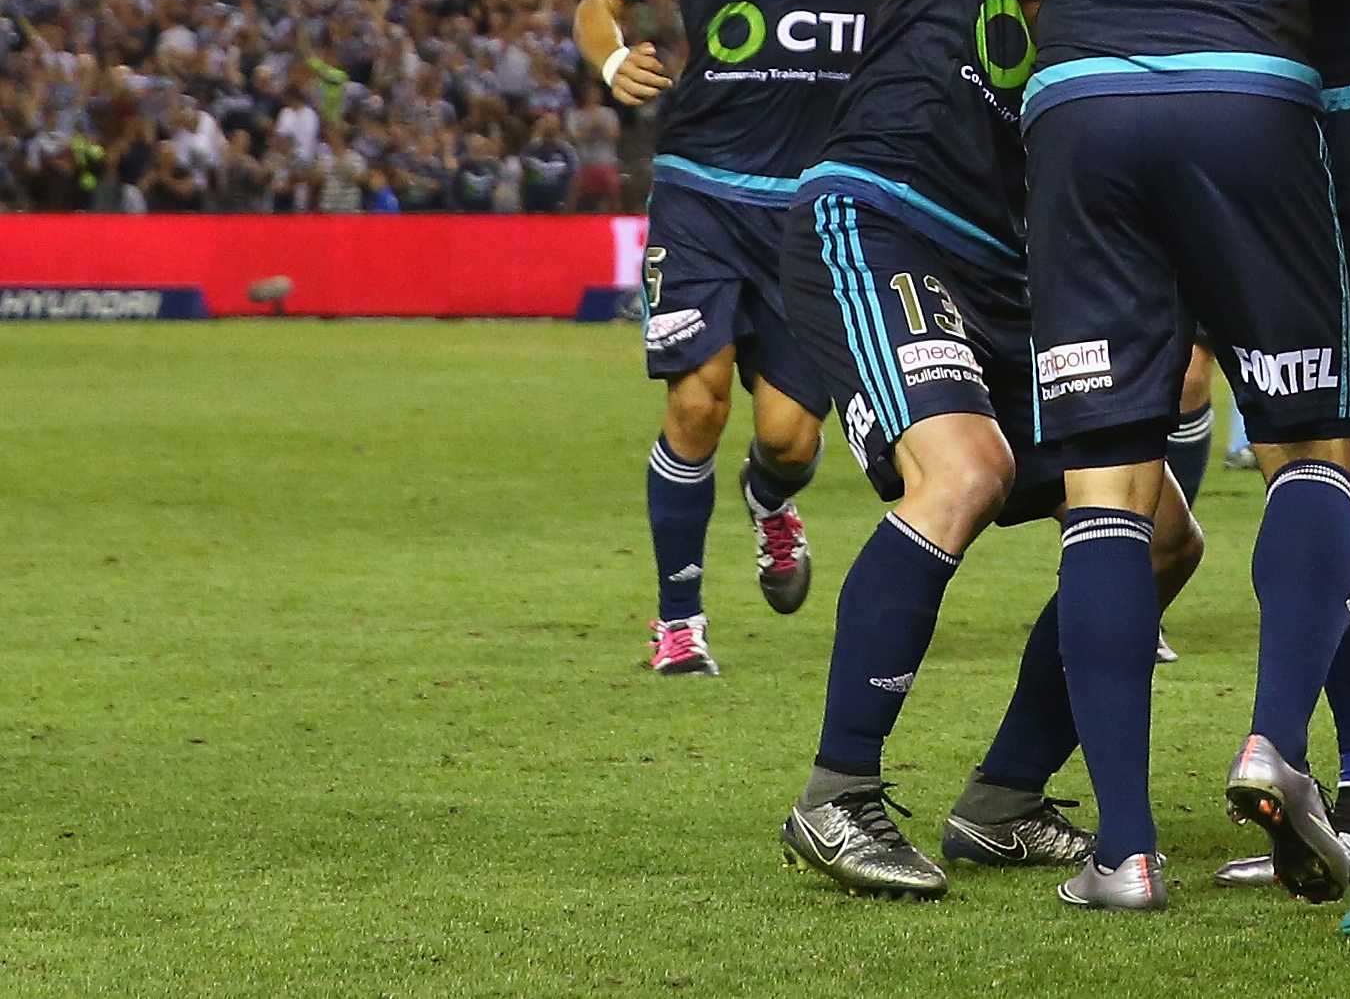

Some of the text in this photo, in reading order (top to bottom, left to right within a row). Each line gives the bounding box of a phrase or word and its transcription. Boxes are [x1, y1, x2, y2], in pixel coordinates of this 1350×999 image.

[776, 9, 865, 53] CTI
[768, 68, 816, 81] Training
[890, 272, 967, 339] 13
[905, 366, 962, 387] building
[1232, 345, 1338, 397] FOXTEL
